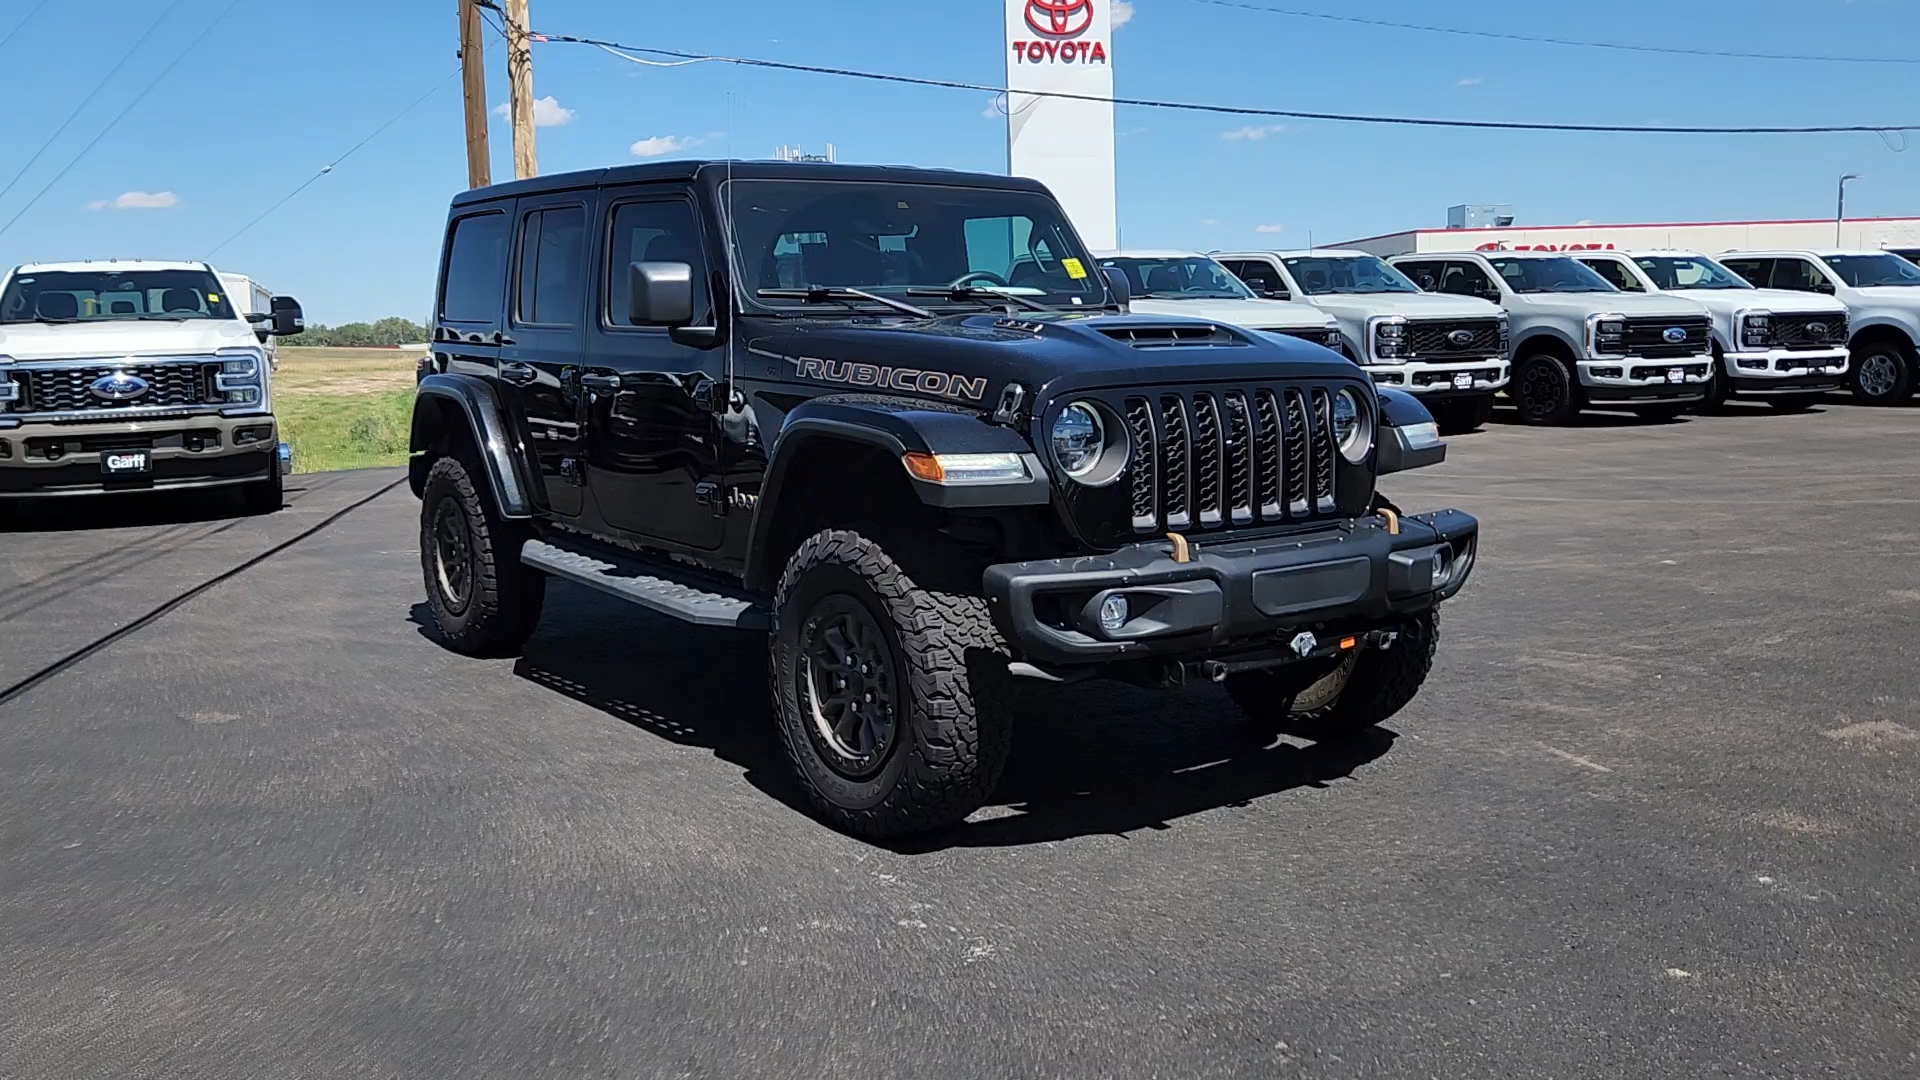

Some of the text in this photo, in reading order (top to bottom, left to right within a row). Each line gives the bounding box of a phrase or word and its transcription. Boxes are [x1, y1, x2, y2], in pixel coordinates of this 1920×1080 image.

[1012, 41, 1106, 64] TOYOTA
[796, 357, 988, 400] RUBICON
[107, 454, 146, 469] Garff
